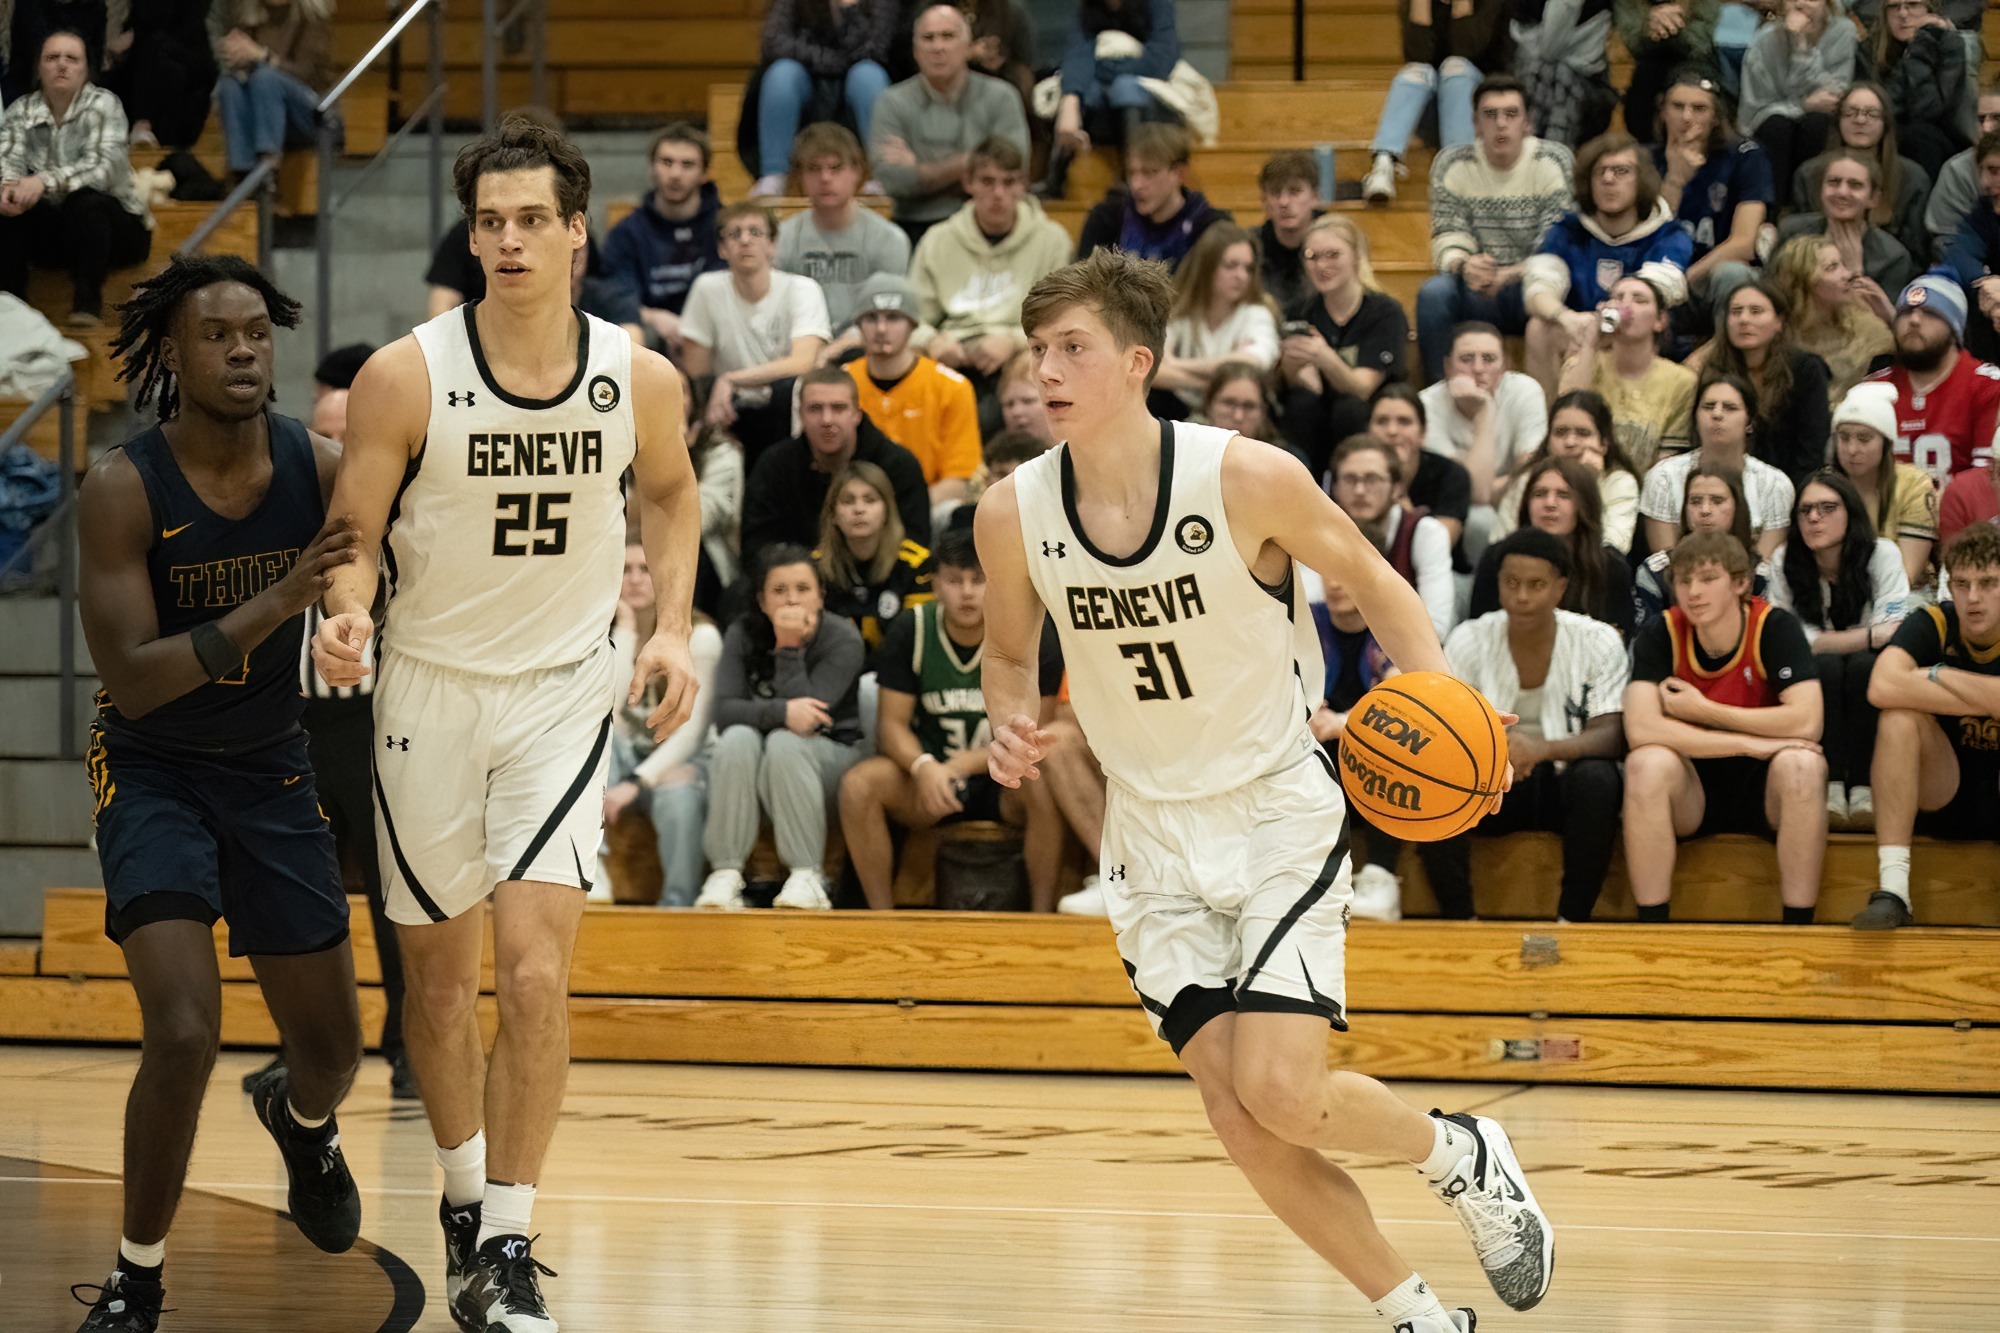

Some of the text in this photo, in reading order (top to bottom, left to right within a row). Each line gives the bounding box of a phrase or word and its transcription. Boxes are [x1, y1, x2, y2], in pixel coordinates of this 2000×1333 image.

[467, 430, 602, 476] GENEVA
[492, 492, 572, 556] 25
[1065, 573, 1206, 630] GENEVA
[1117, 640, 1194, 701] 31
[1360, 703, 1432, 756] NCAA
[1340, 739, 1422, 811] Wilson
